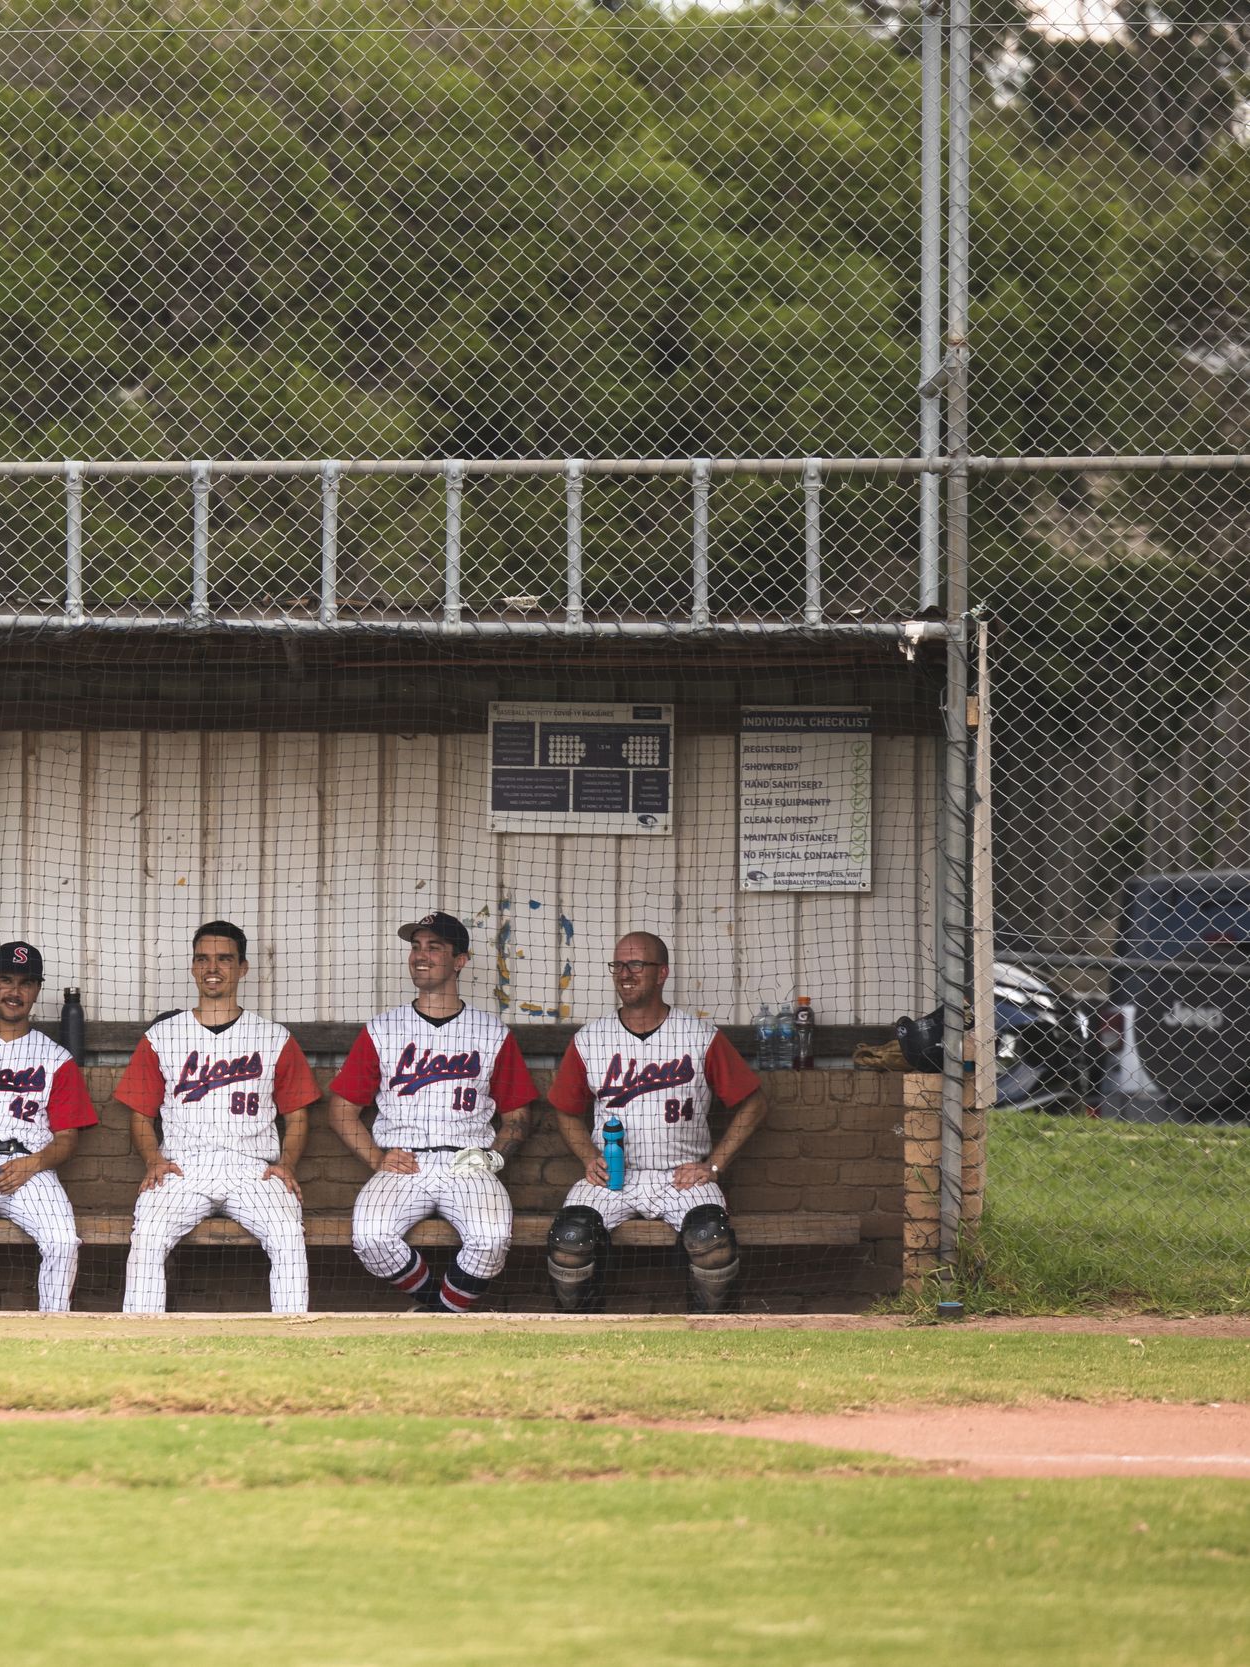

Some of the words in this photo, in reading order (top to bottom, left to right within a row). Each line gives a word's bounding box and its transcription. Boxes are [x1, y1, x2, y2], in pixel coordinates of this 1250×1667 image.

[742, 717, 807, 727] INDIVIDUAL
[809, 717, 871, 727] CHECKLIST
[743, 745, 803, 754] REGISTERED?
[744, 763, 799, 771] SHOWERED?
[744, 780, 770, 789] HAND
[772, 780, 823, 789] SANITISER?
[744, 798, 773, 806] CLEAN
[775, 798, 831, 807] EQUIPMENT?
[743, 816, 772, 824] CLEAN
[774, 816, 819, 824] CLOTHES?
[743, 833, 788, 842] MAINTAIN
[789, 833, 838, 842] DISTANCE?
[743, 851, 757, 859] NO
[758, 851, 801, 860] PHYSICAL
[803, 851, 849, 860] CONTACT?
[12, 946, 28, 964] S
[1163, 1000, 1224, 1032] Jeep
[173, 1049, 263, 1105] Lions
[389, 1042, 481, 1097] Lions
[597, 1053, 695, 1108] Lions
[230, 1091, 260, 1117] 66
[452, 1086, 478, 1112] 19
[9, 1095, 40, 1123] 42
[664, 1097, 694, 1124] 84
